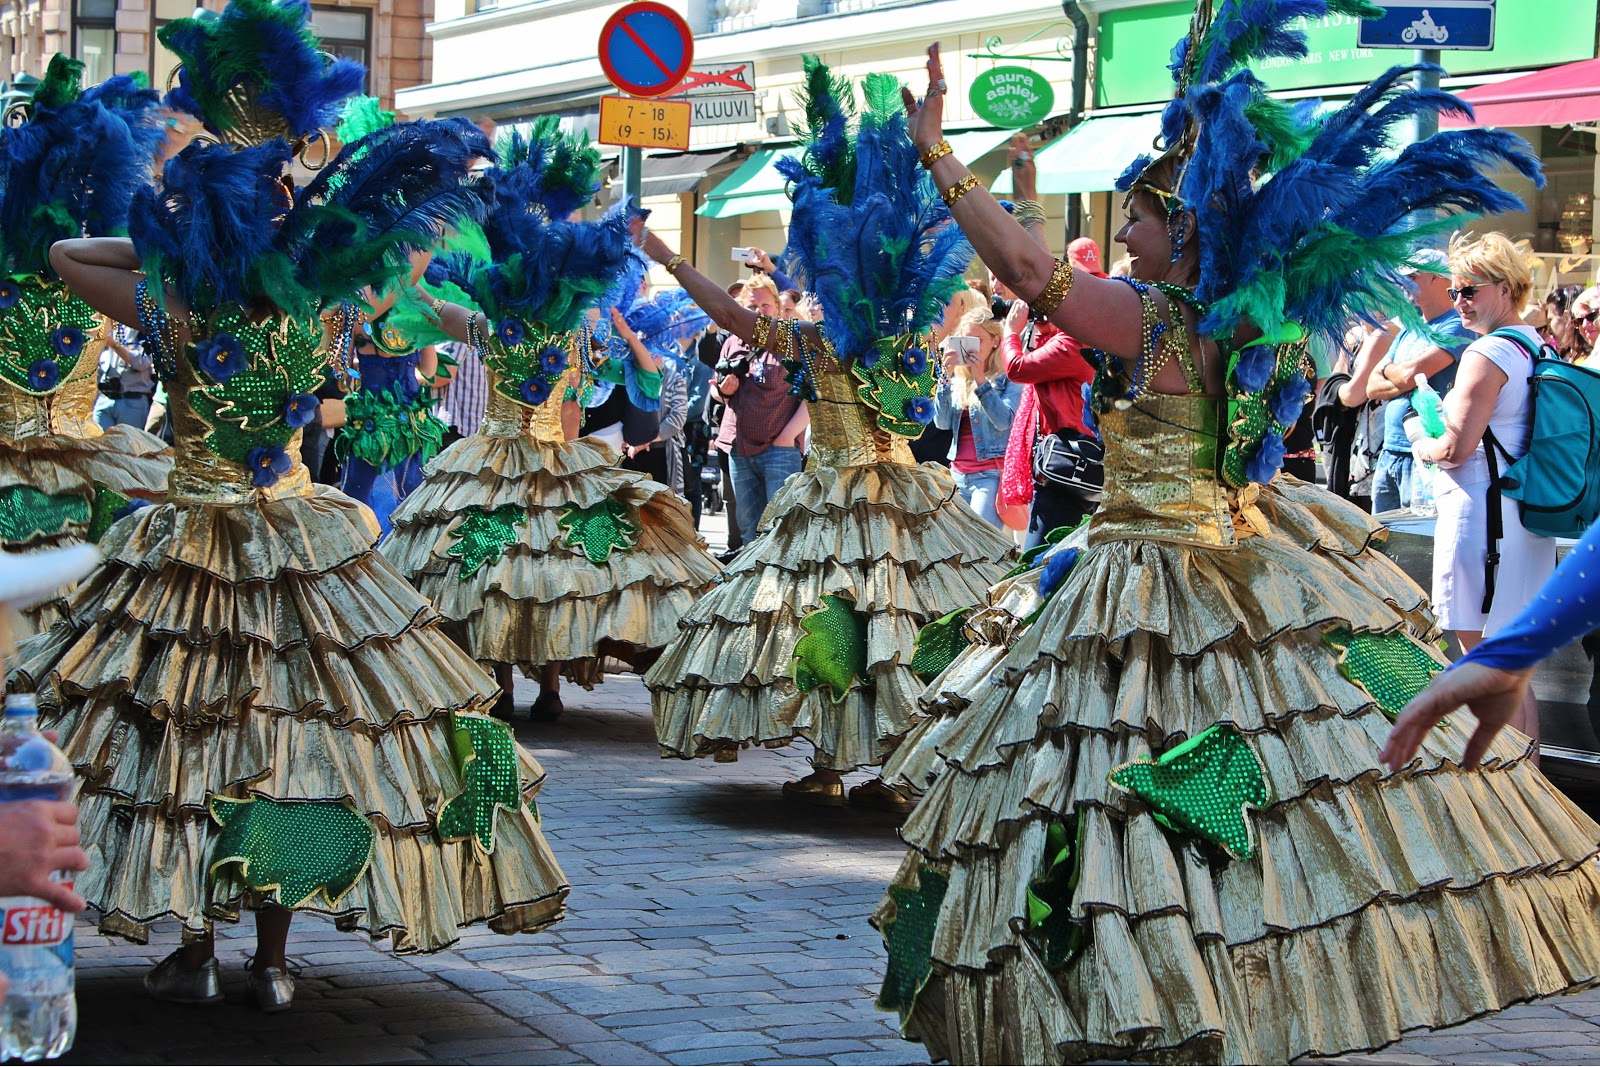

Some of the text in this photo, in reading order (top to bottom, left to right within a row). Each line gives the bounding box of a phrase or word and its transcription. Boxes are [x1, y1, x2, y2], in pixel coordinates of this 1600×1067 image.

[1261, 56, 1294, 70] LONDON
[1329, 49, 1348, 61] NEW
[1350, 48, 1374, 60] YORK
[989, 73, 1034, 87] laura
[986, 84, 1039, 104] ashley
[627, 105, 634, 119] 7
[652, 107, 665, 121] 18
[694, 100, 748, 119] KLUUVI
[618, 124, 632, 138] (9
[652, 127, 671, 141] 15)
[7, 909, 60, 942] Siti
